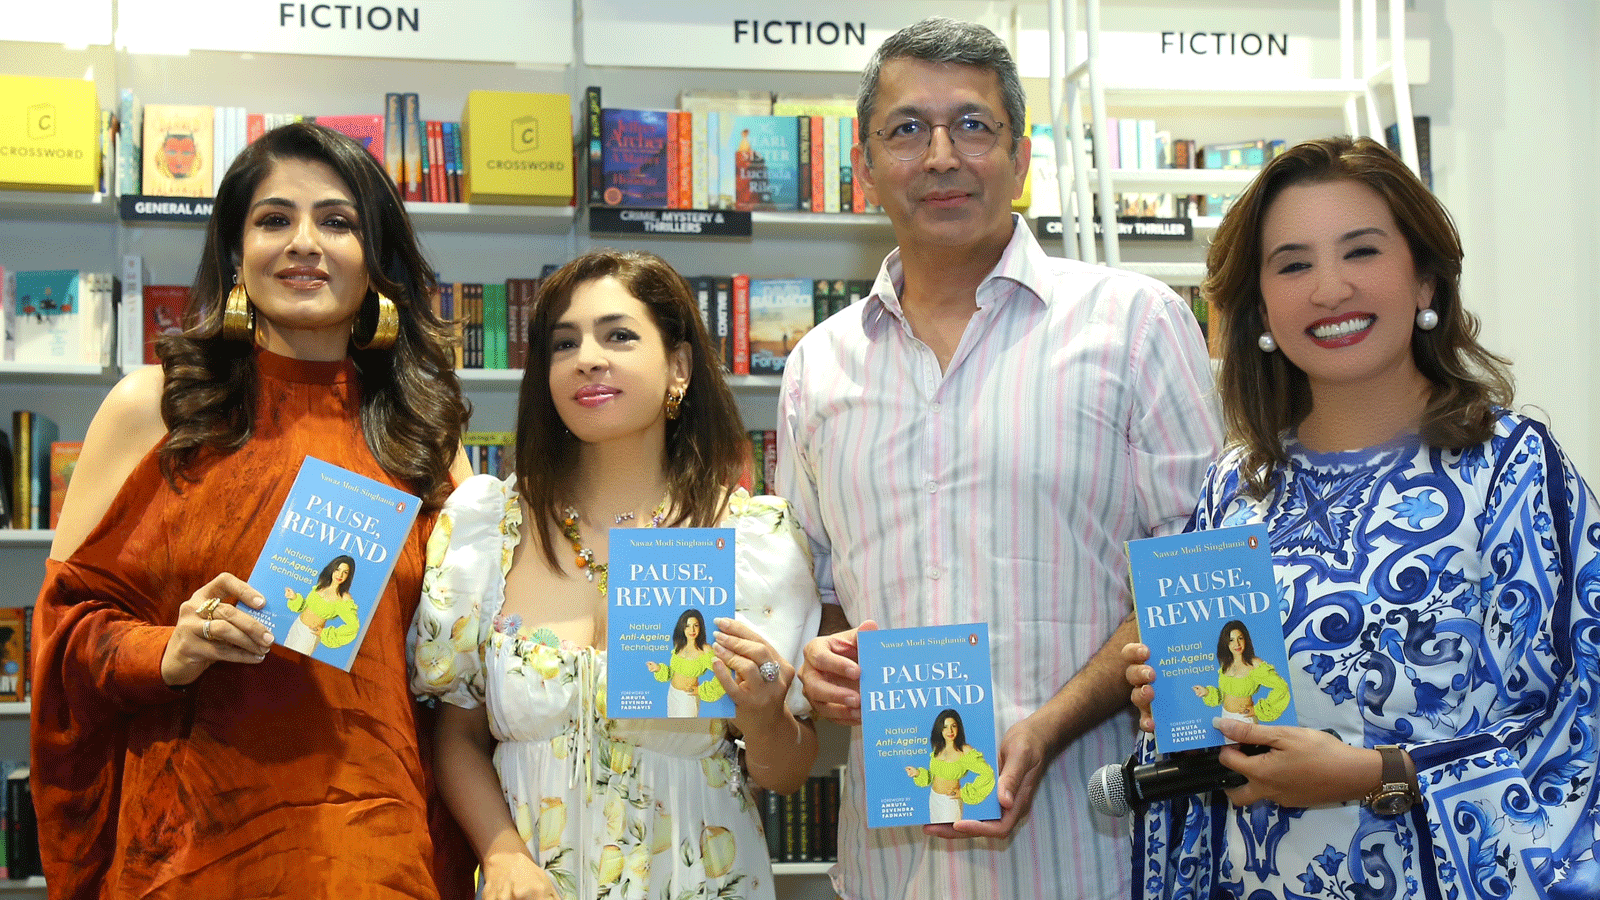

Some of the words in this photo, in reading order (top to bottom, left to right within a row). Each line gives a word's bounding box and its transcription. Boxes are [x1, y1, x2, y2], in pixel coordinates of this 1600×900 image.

[280, 3, 419, 32] FICTION
[734, 20, 867, 46] FICTION
[1161, 32, 1289, 56] FICTION
[38, 115, 51, 130] C
[522, 128, 534, 144] C
[0, 146, 83, 159] CROSSWORD
[486, 159, 564, 171] CROSSWORD
[135, 201, 192, 215] GENERAL
[620, 210, 660, 223] CRIME,
[661, 211, 713, 223] MYSTERY
[715, 212, 725, 223] &
[644, 221, 702, 234] THRILLERS
[1135, 223, 1186, 235] THRILLER
[320, 472, 341, 487] Nawaz
[342, 480, 360, 493] Modi
[359, 487, 395, 507] Singhania
[305, 494, 381, 539] PAUSE,
[282, 511, 387, 564] REWIND
[630, 539, 653, 547] Nawaz
[655, 538, 674, 547] Modi
[676, 538, 714, 548] Singhania
[285, 547, 314, 564] Natural
[1153, 549, 1180, 559] Nawaz
[1181, 545, 1202, 554] Modi
[1203, 540, 1246, 552] Singhania
[271, 553, 319, 577] Anti-Ageing
[269, 563, 314, 585] Techniques
[629, 563, 714, 585] PAUSE,
[1157, 567, 1251, 598] PAUSE,
[615, 586, 728, 607] REWIND
[1144, 591, 1270, 629] REWIND
[629, 623, 661, 631] Natural
[619, 633, 671, 642] Anti-Ageing
[880, 641, 904, 649] Nawaz
[906, 638, 926, 647] Modi
[927, 636, 966, 646] Singhania
[621, 643, 669, 652] Techniques
[1167, 641, 1202, 653] Natural
[1158, 651, 1215, 666] Anti-Ageing
[881, 661, 969, 684] PAUSE,
[1161, 664, 1215, 678] Techniques
[868, 684, 985, 712] REWIND
[885, 726, 918, 735] Natural
[1171, 725, 1198, 733] AMRUTA
[1171, 729, 1207, 738] DEVENDRA
[875, 736, 928, 747] Anti-Ageing
[1173, 734, 1206, 744] FADNAVIS
[877, 748, 928, 757] Techniques
